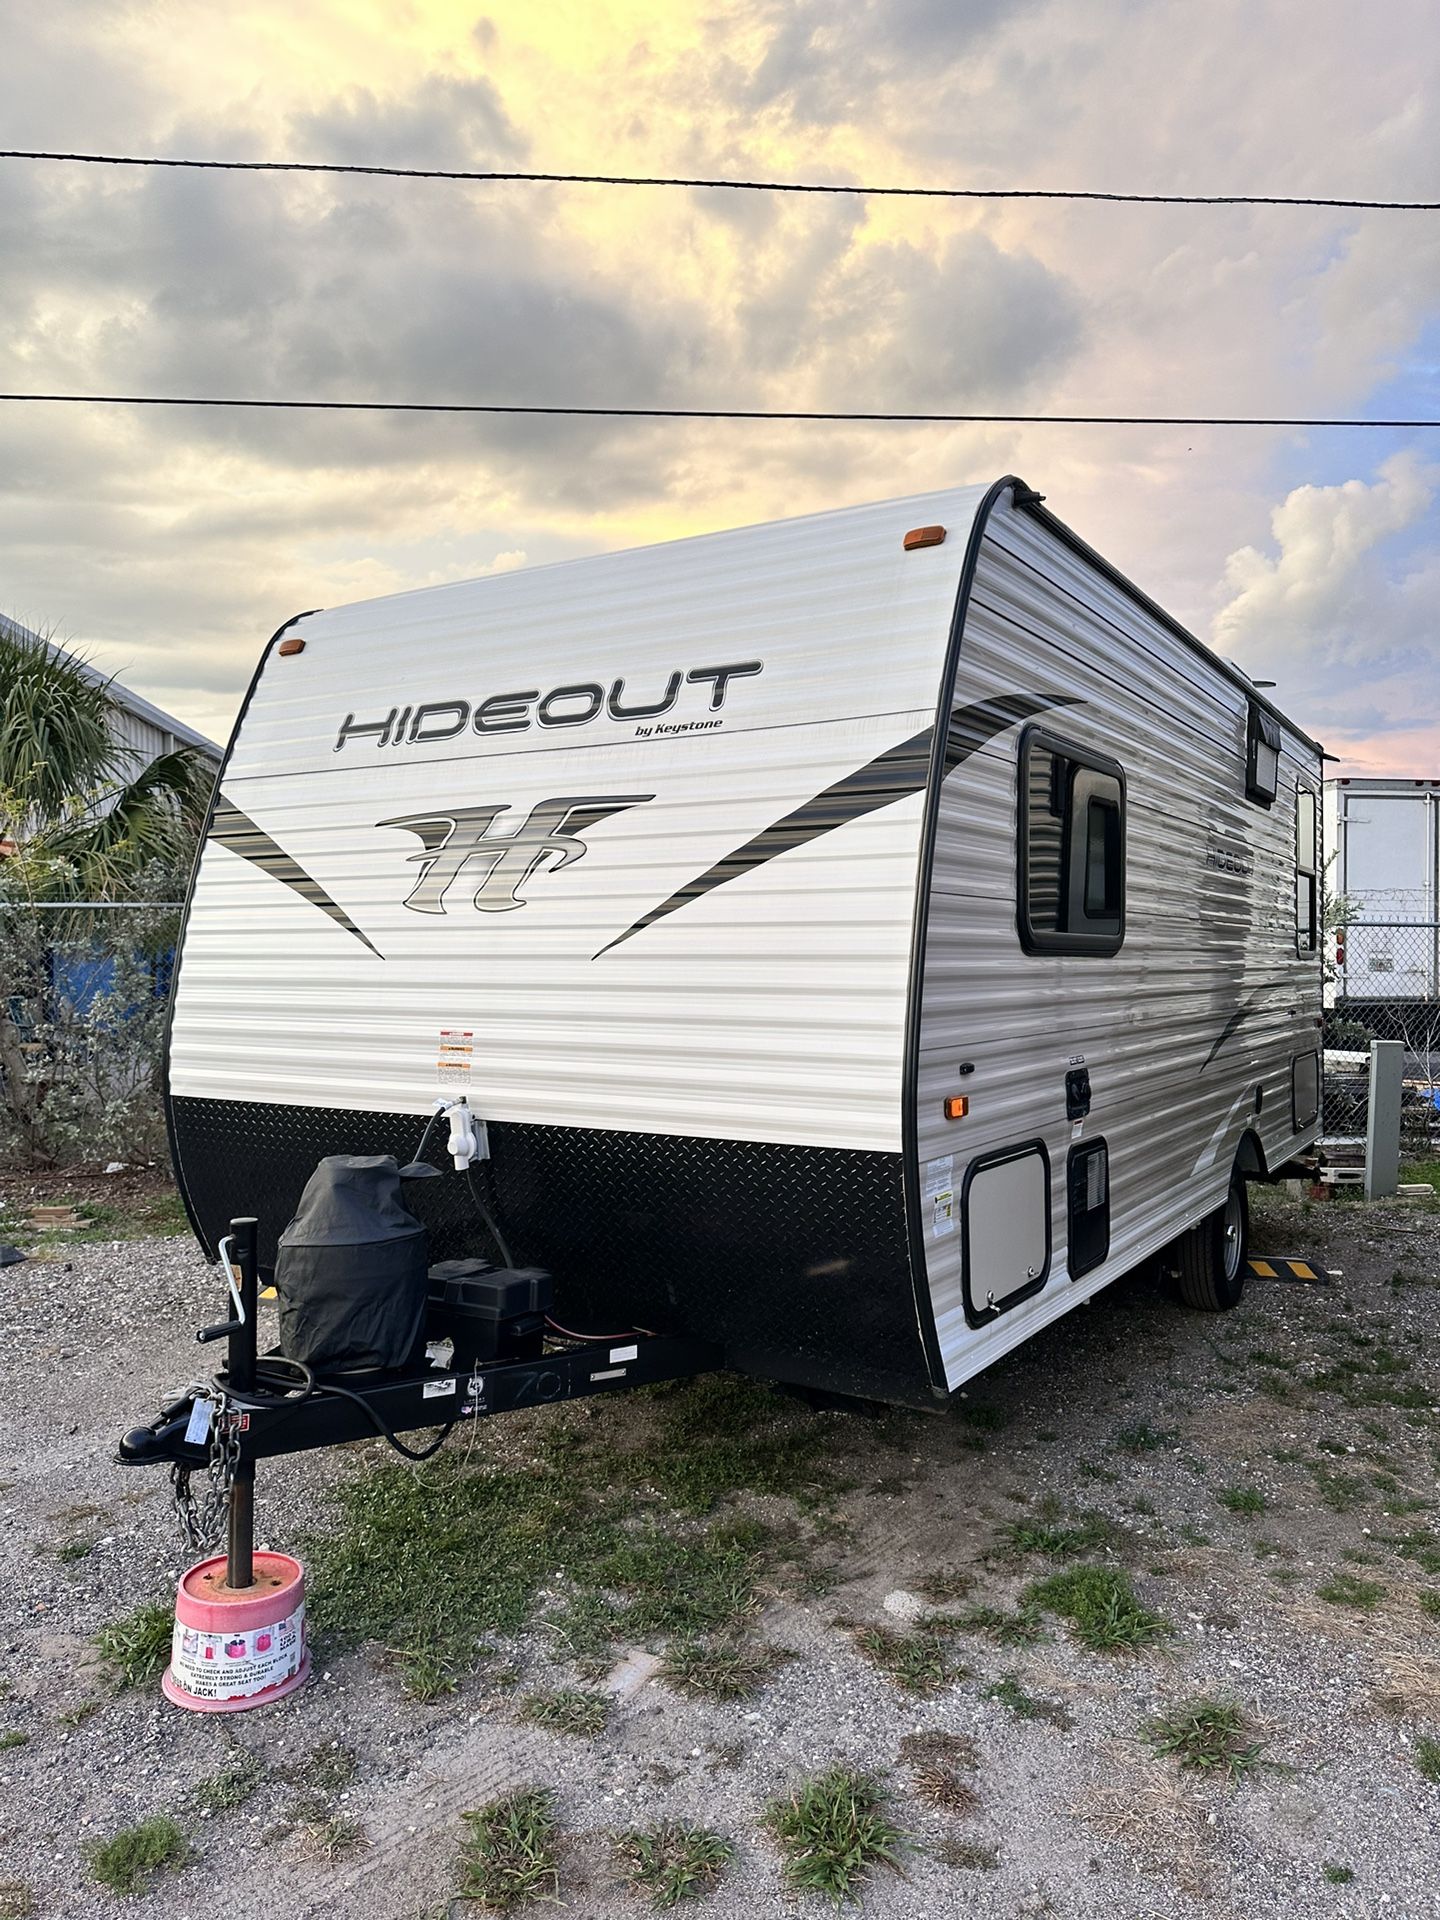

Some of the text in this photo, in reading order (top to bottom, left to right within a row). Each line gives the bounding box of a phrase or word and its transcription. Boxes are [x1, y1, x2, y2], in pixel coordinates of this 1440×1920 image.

[333, 658, 764, 752] HIDEOUT
[635, 719, 723, 738] by Keystone
[190, 1672, 218, 1681] EXTREMELY
[249, 1666, 273, 1676] DURABLE
[235, 1666, 257, 1674] ADJUST
[257, 1660, 272, 1669] EACH
[219, 1679, 237, 1687] GREAT
[193, 1686, 217, 1698] JACK!
